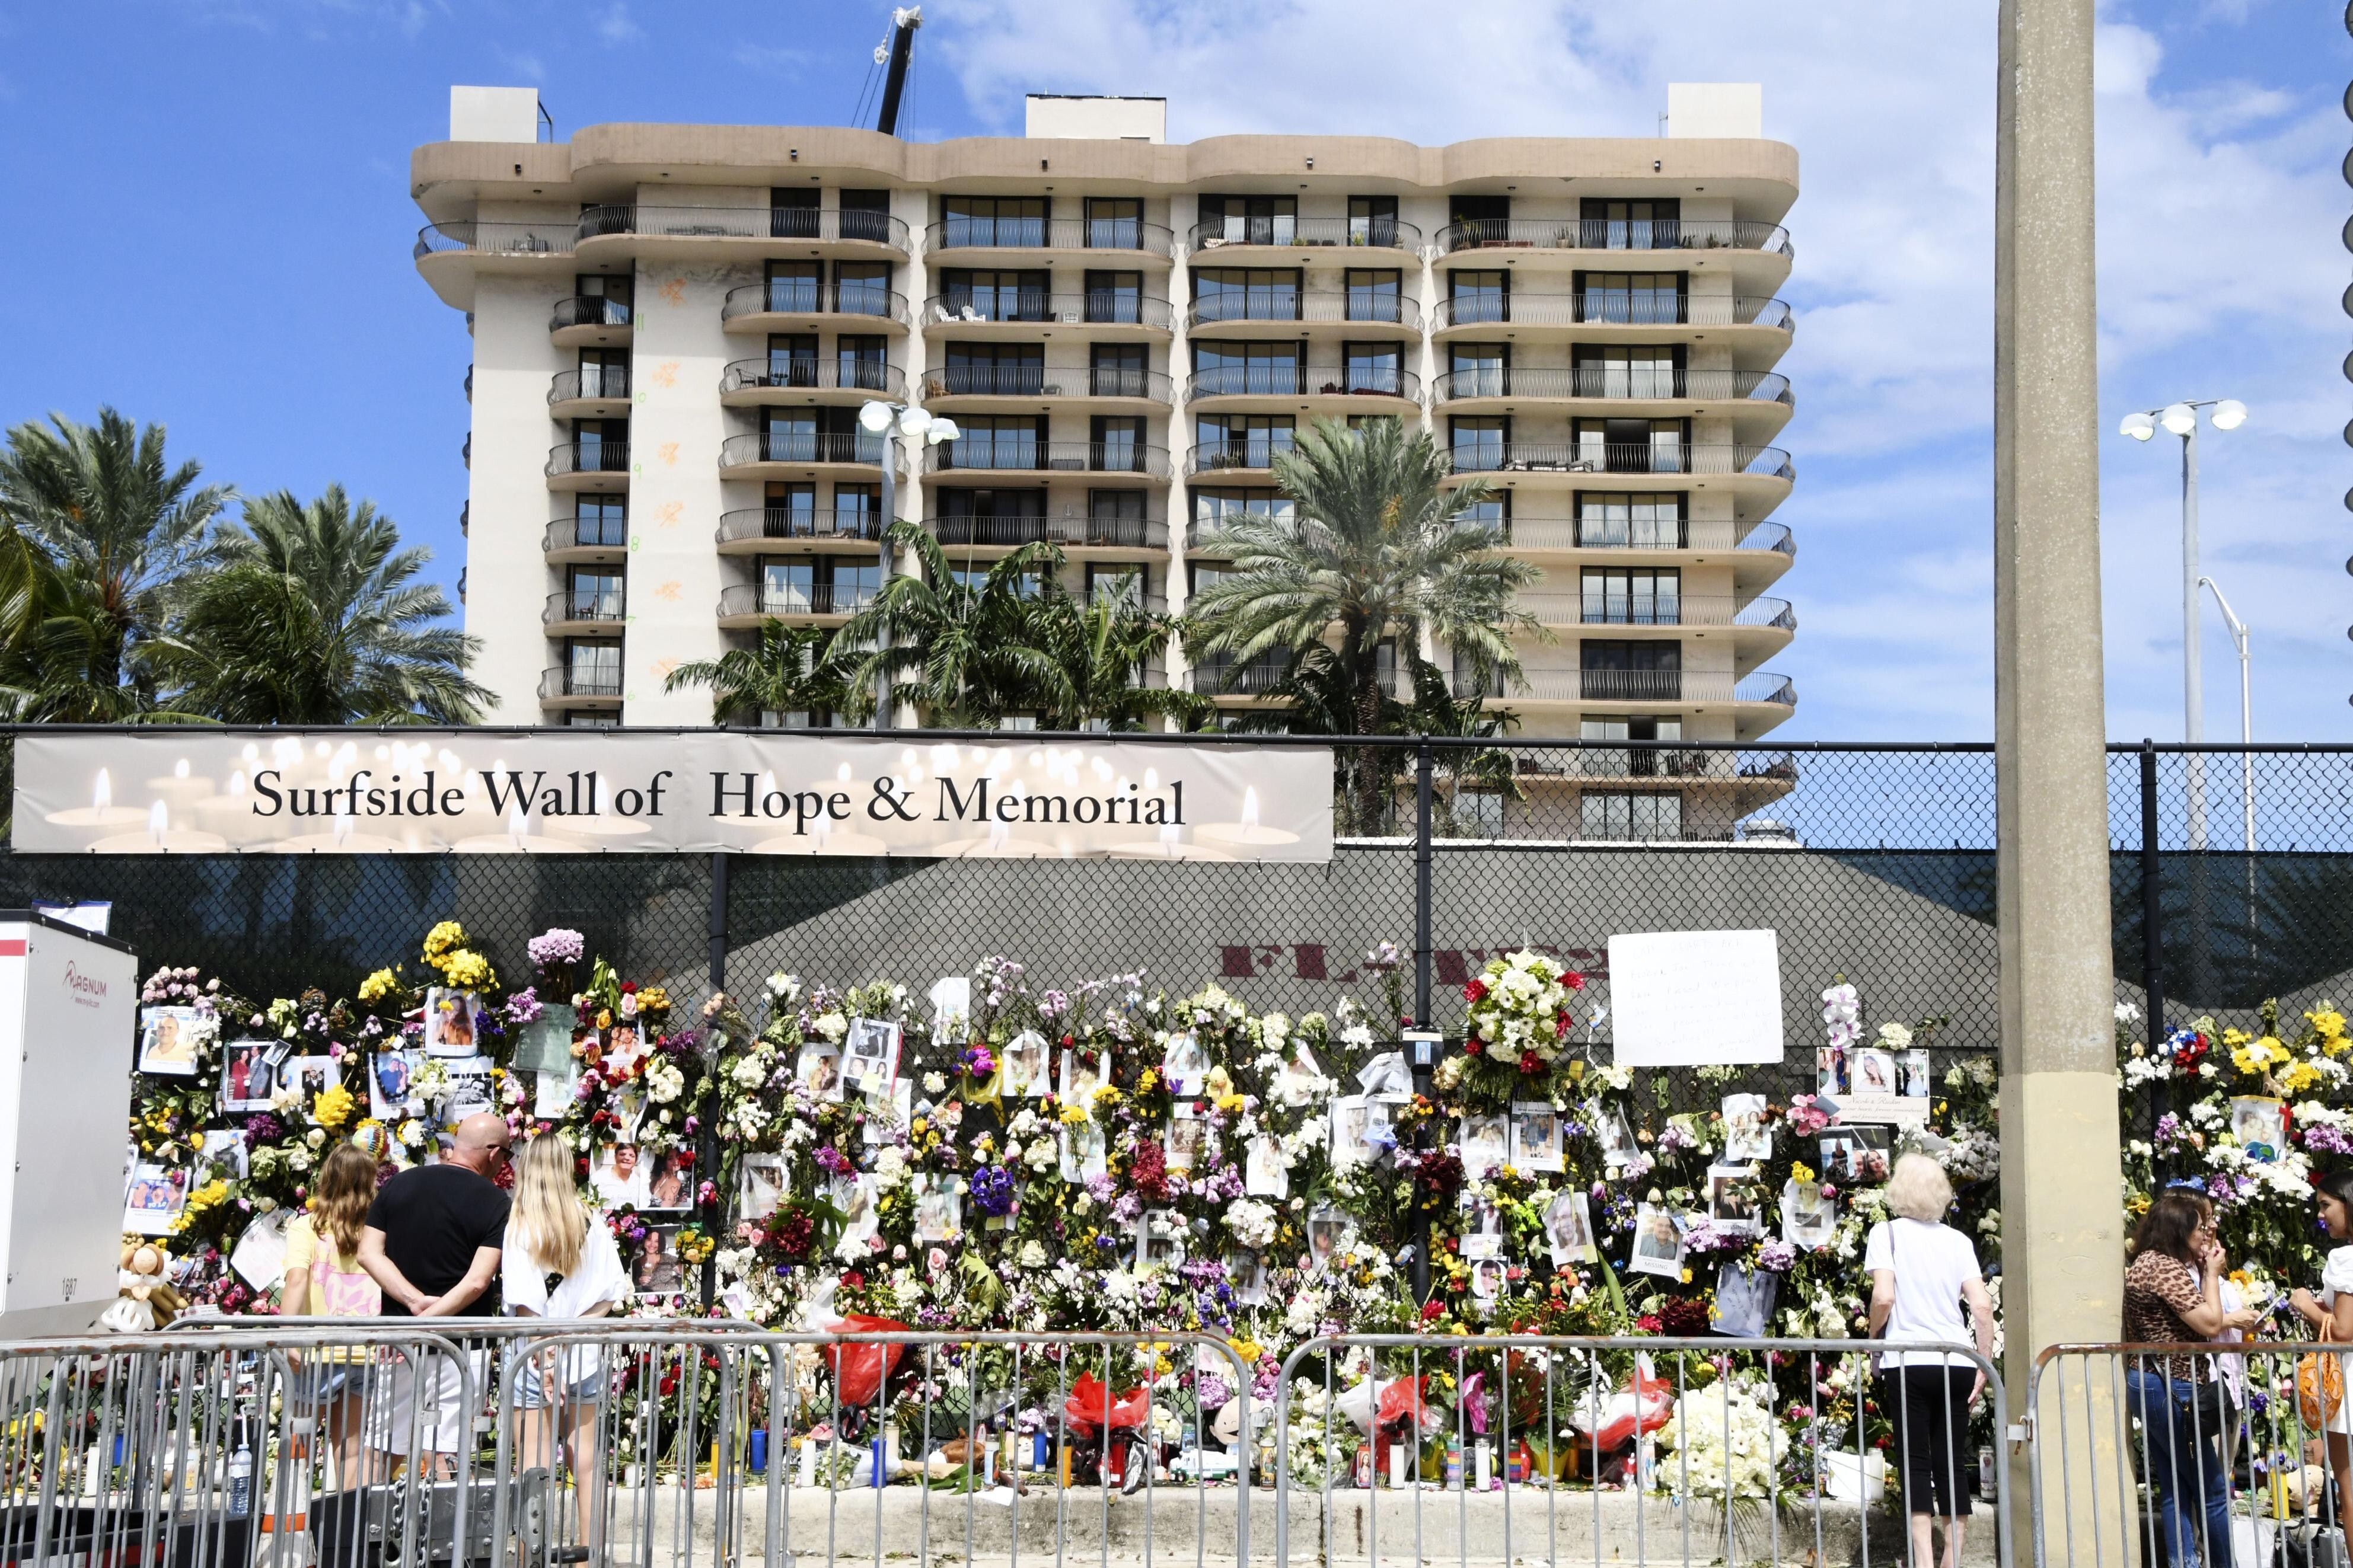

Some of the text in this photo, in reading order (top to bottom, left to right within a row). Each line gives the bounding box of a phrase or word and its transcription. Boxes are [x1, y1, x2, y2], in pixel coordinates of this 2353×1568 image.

[634, 391, 646, 406] 10
[633, 463, 642, 479] 9
[630, 535, 640, 552] 8
[253, 771, 1185, 835] Surfside Wall of Hope & Memorial
[62, 967, 107, 998] MAGNUM
[1644, 1262, 1668, 1270] MISSING
[62, 1278, 77, 1296] 1687
